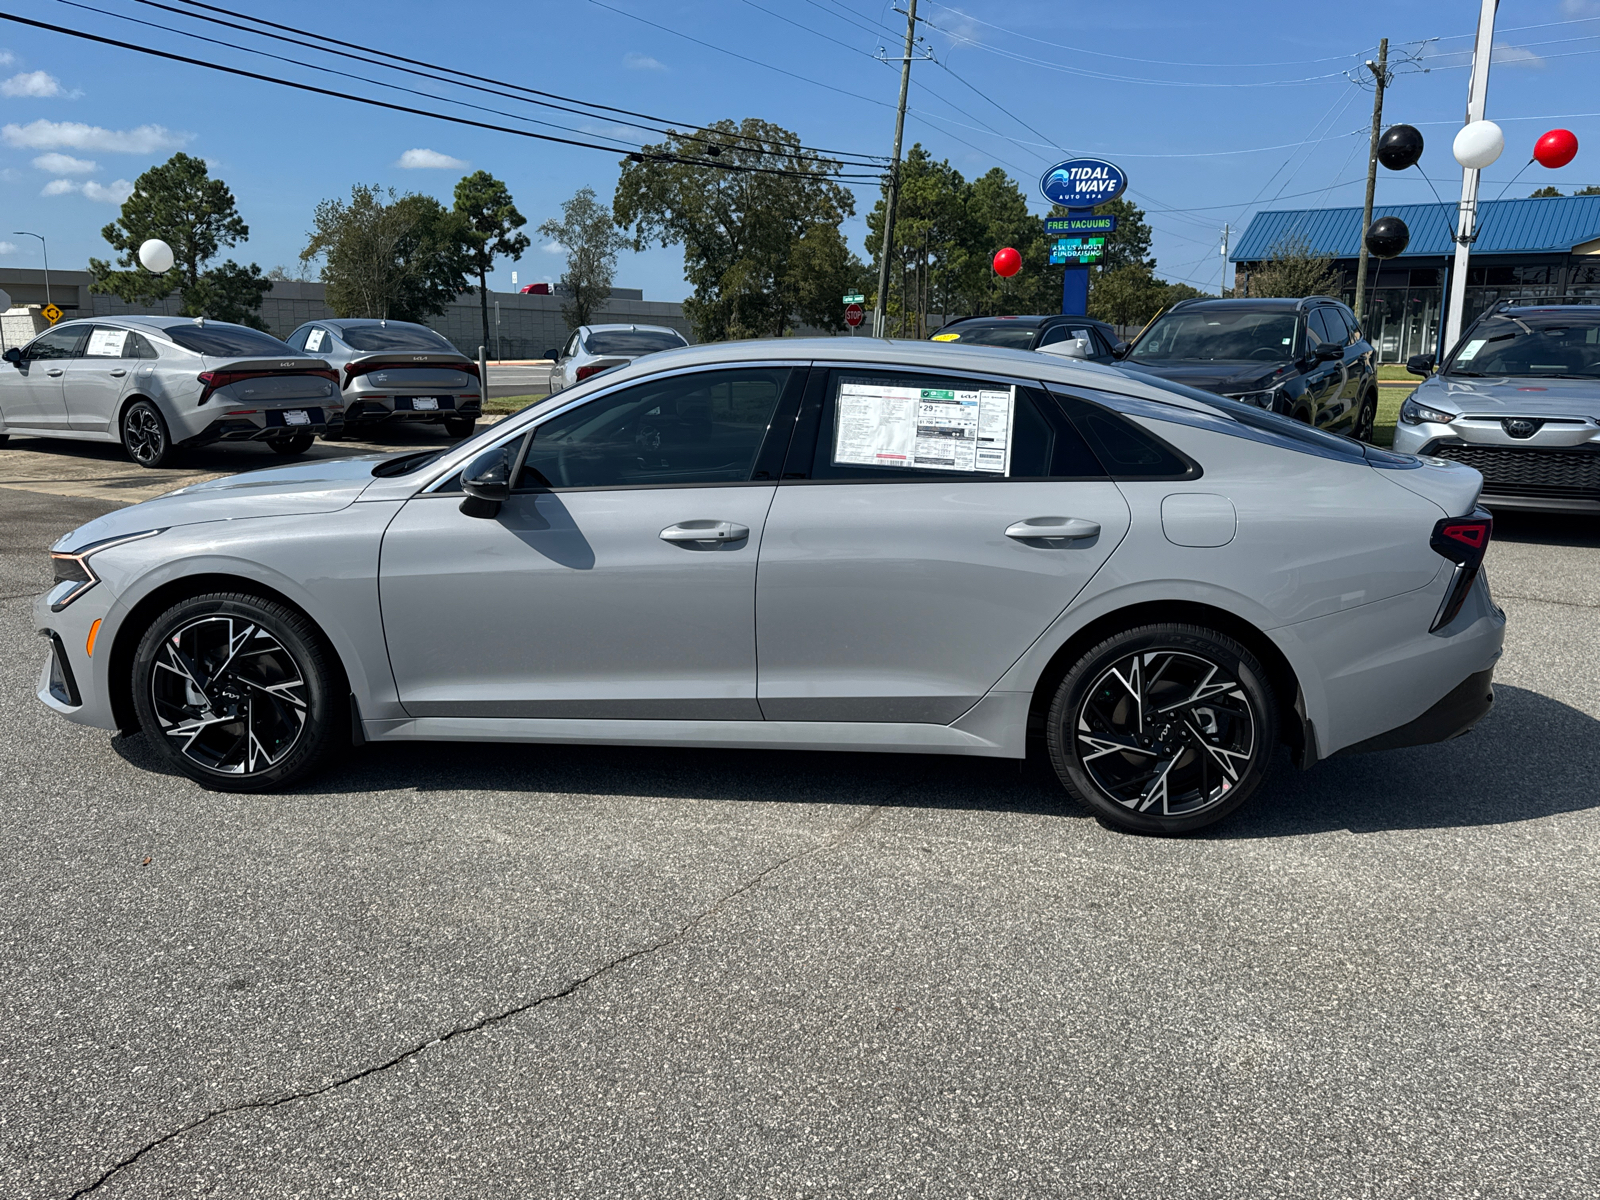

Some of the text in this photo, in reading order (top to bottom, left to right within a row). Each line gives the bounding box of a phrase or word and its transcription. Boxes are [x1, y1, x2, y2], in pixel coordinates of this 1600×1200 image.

[1070, 167, 1108, 179] TIDAL
[1075, 179, 1117, 192] WAVE
[1048, 219, 1110, 229] FREE VACUUMS
[846, 310, 861, 320] STOP
[923, 404, 934, 412] 29
